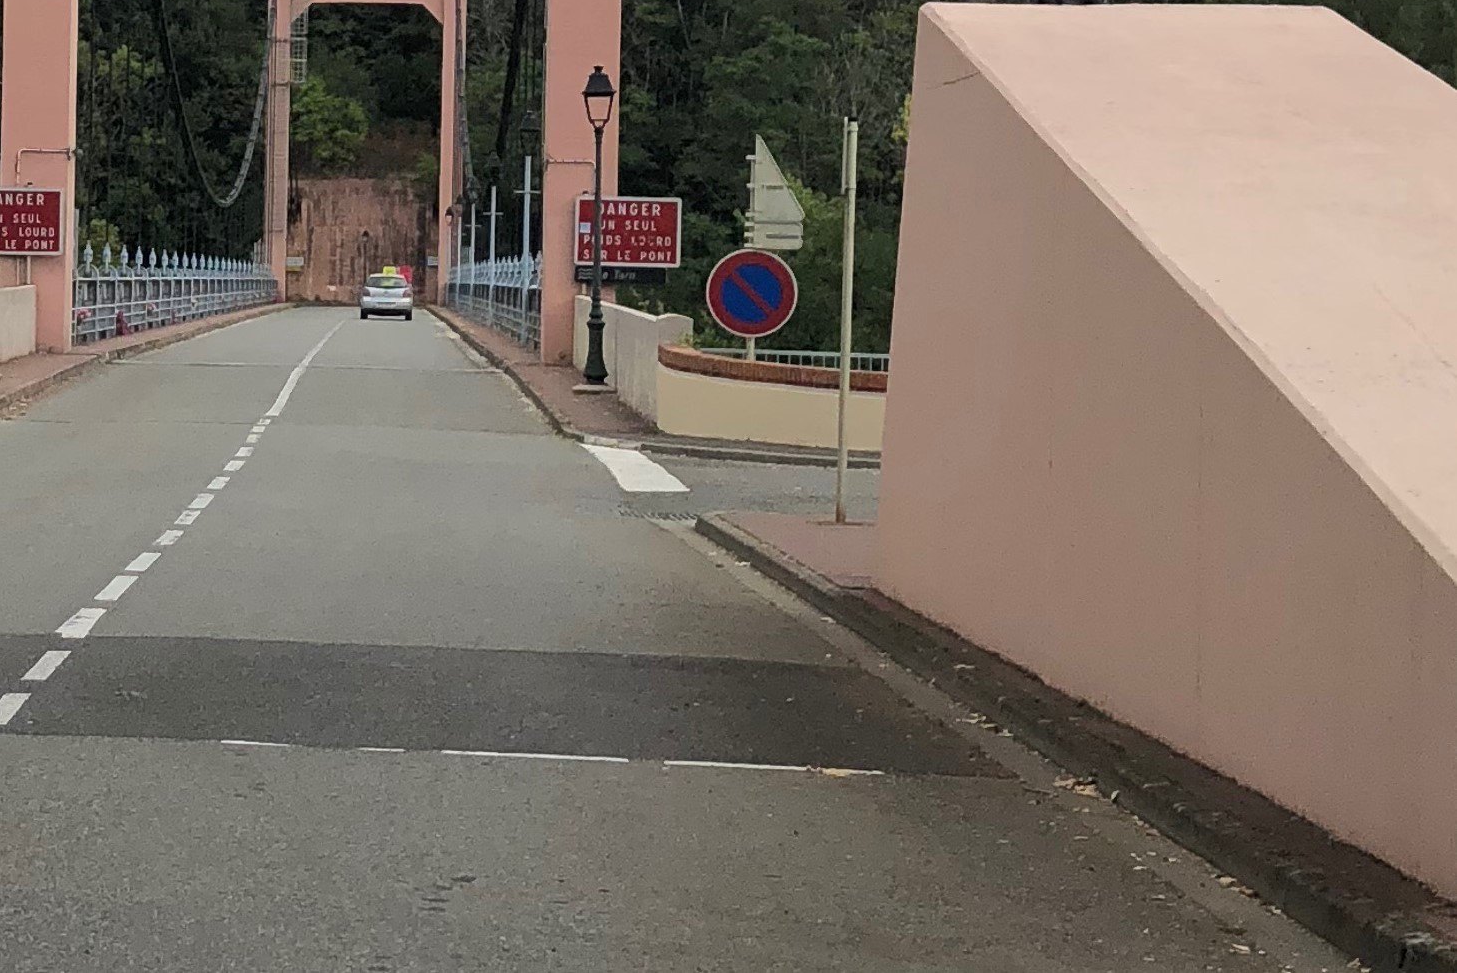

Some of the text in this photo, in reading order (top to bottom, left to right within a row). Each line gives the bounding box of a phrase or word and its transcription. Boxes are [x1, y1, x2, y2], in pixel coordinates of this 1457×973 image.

[12, 213, 42, 224] SEUL
[624, 220, 657, 232] SEUL
[18, 227, 56, 238] LOURD
[4, 239, 17, 250] LE
[24, 240, 55, 250] PONT
[583, 249, 672, 262] SR LE PONT
